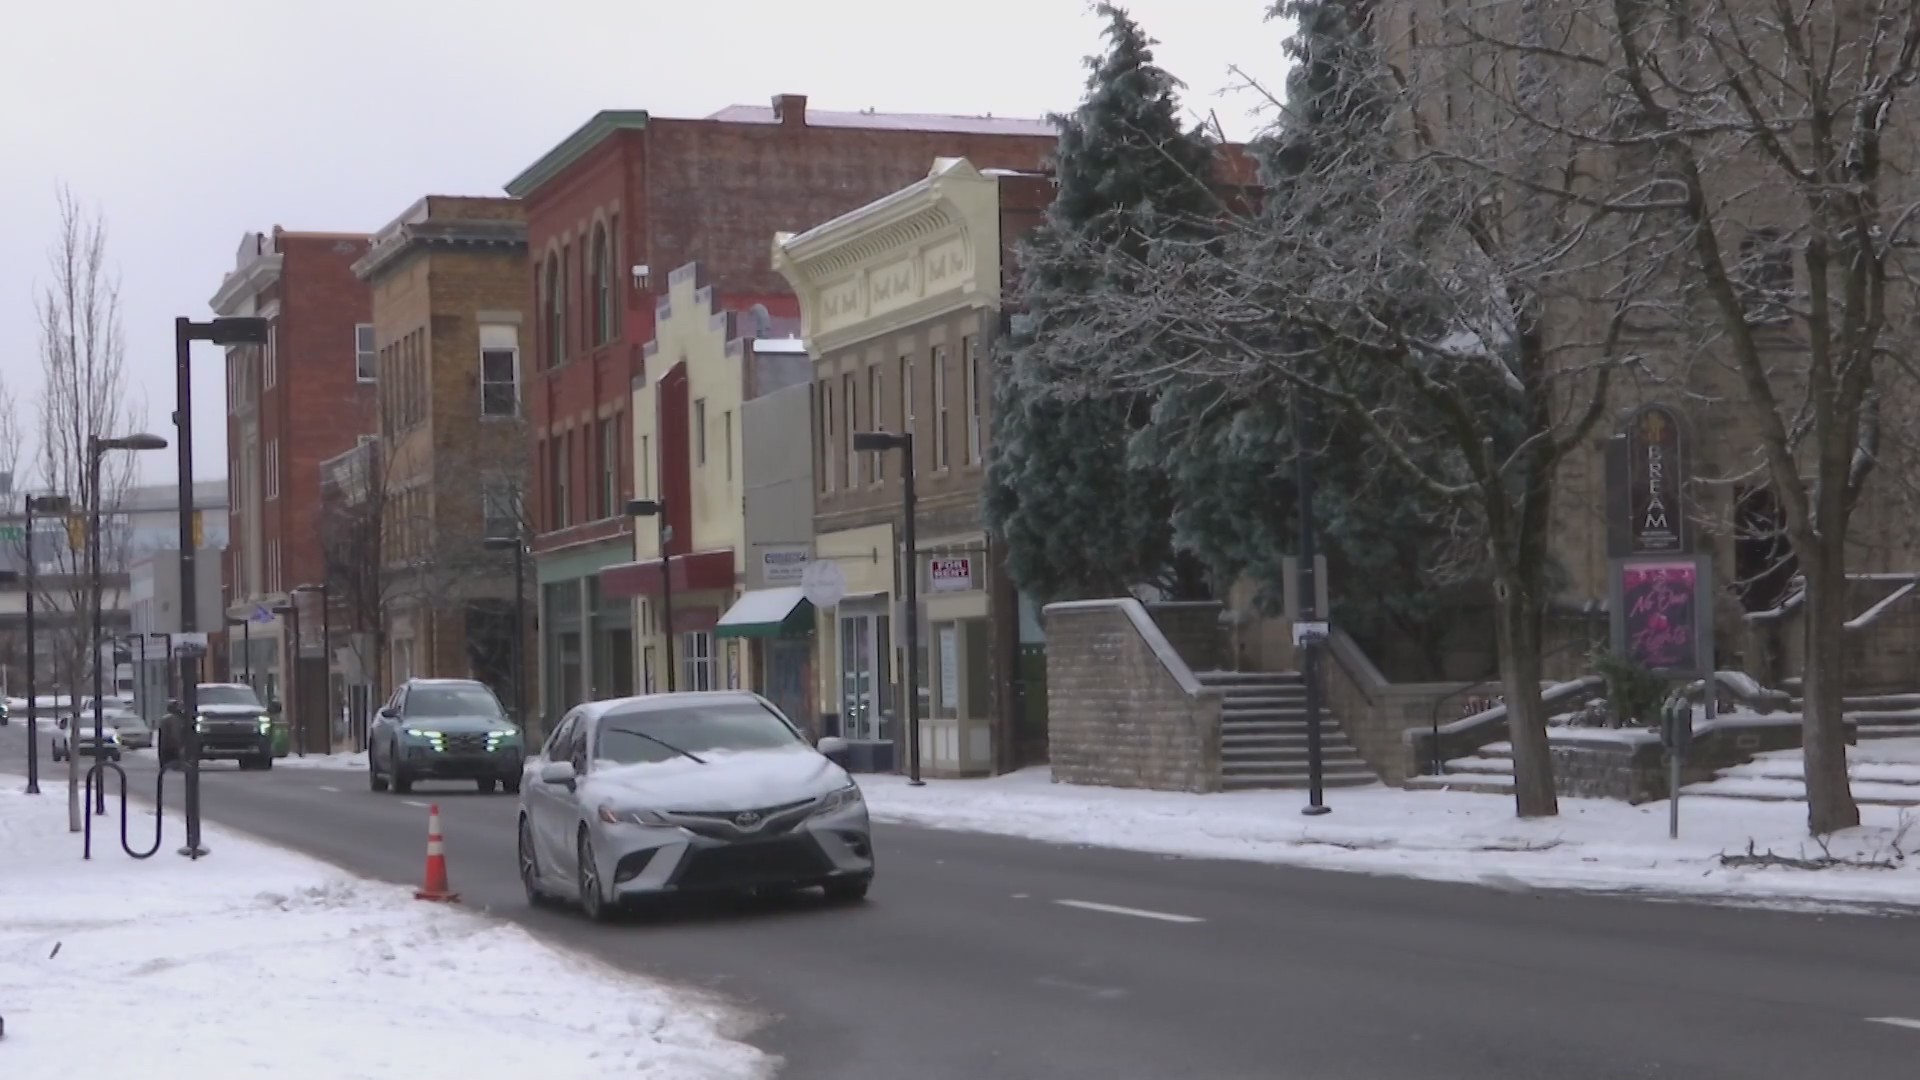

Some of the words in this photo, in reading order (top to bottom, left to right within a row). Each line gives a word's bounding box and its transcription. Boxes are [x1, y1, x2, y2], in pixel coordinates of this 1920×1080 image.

[1644, 446, 1668, 528] BREAM
[937, 560, 963, 570] FOR
[933, 568, 969, 578] RENT
